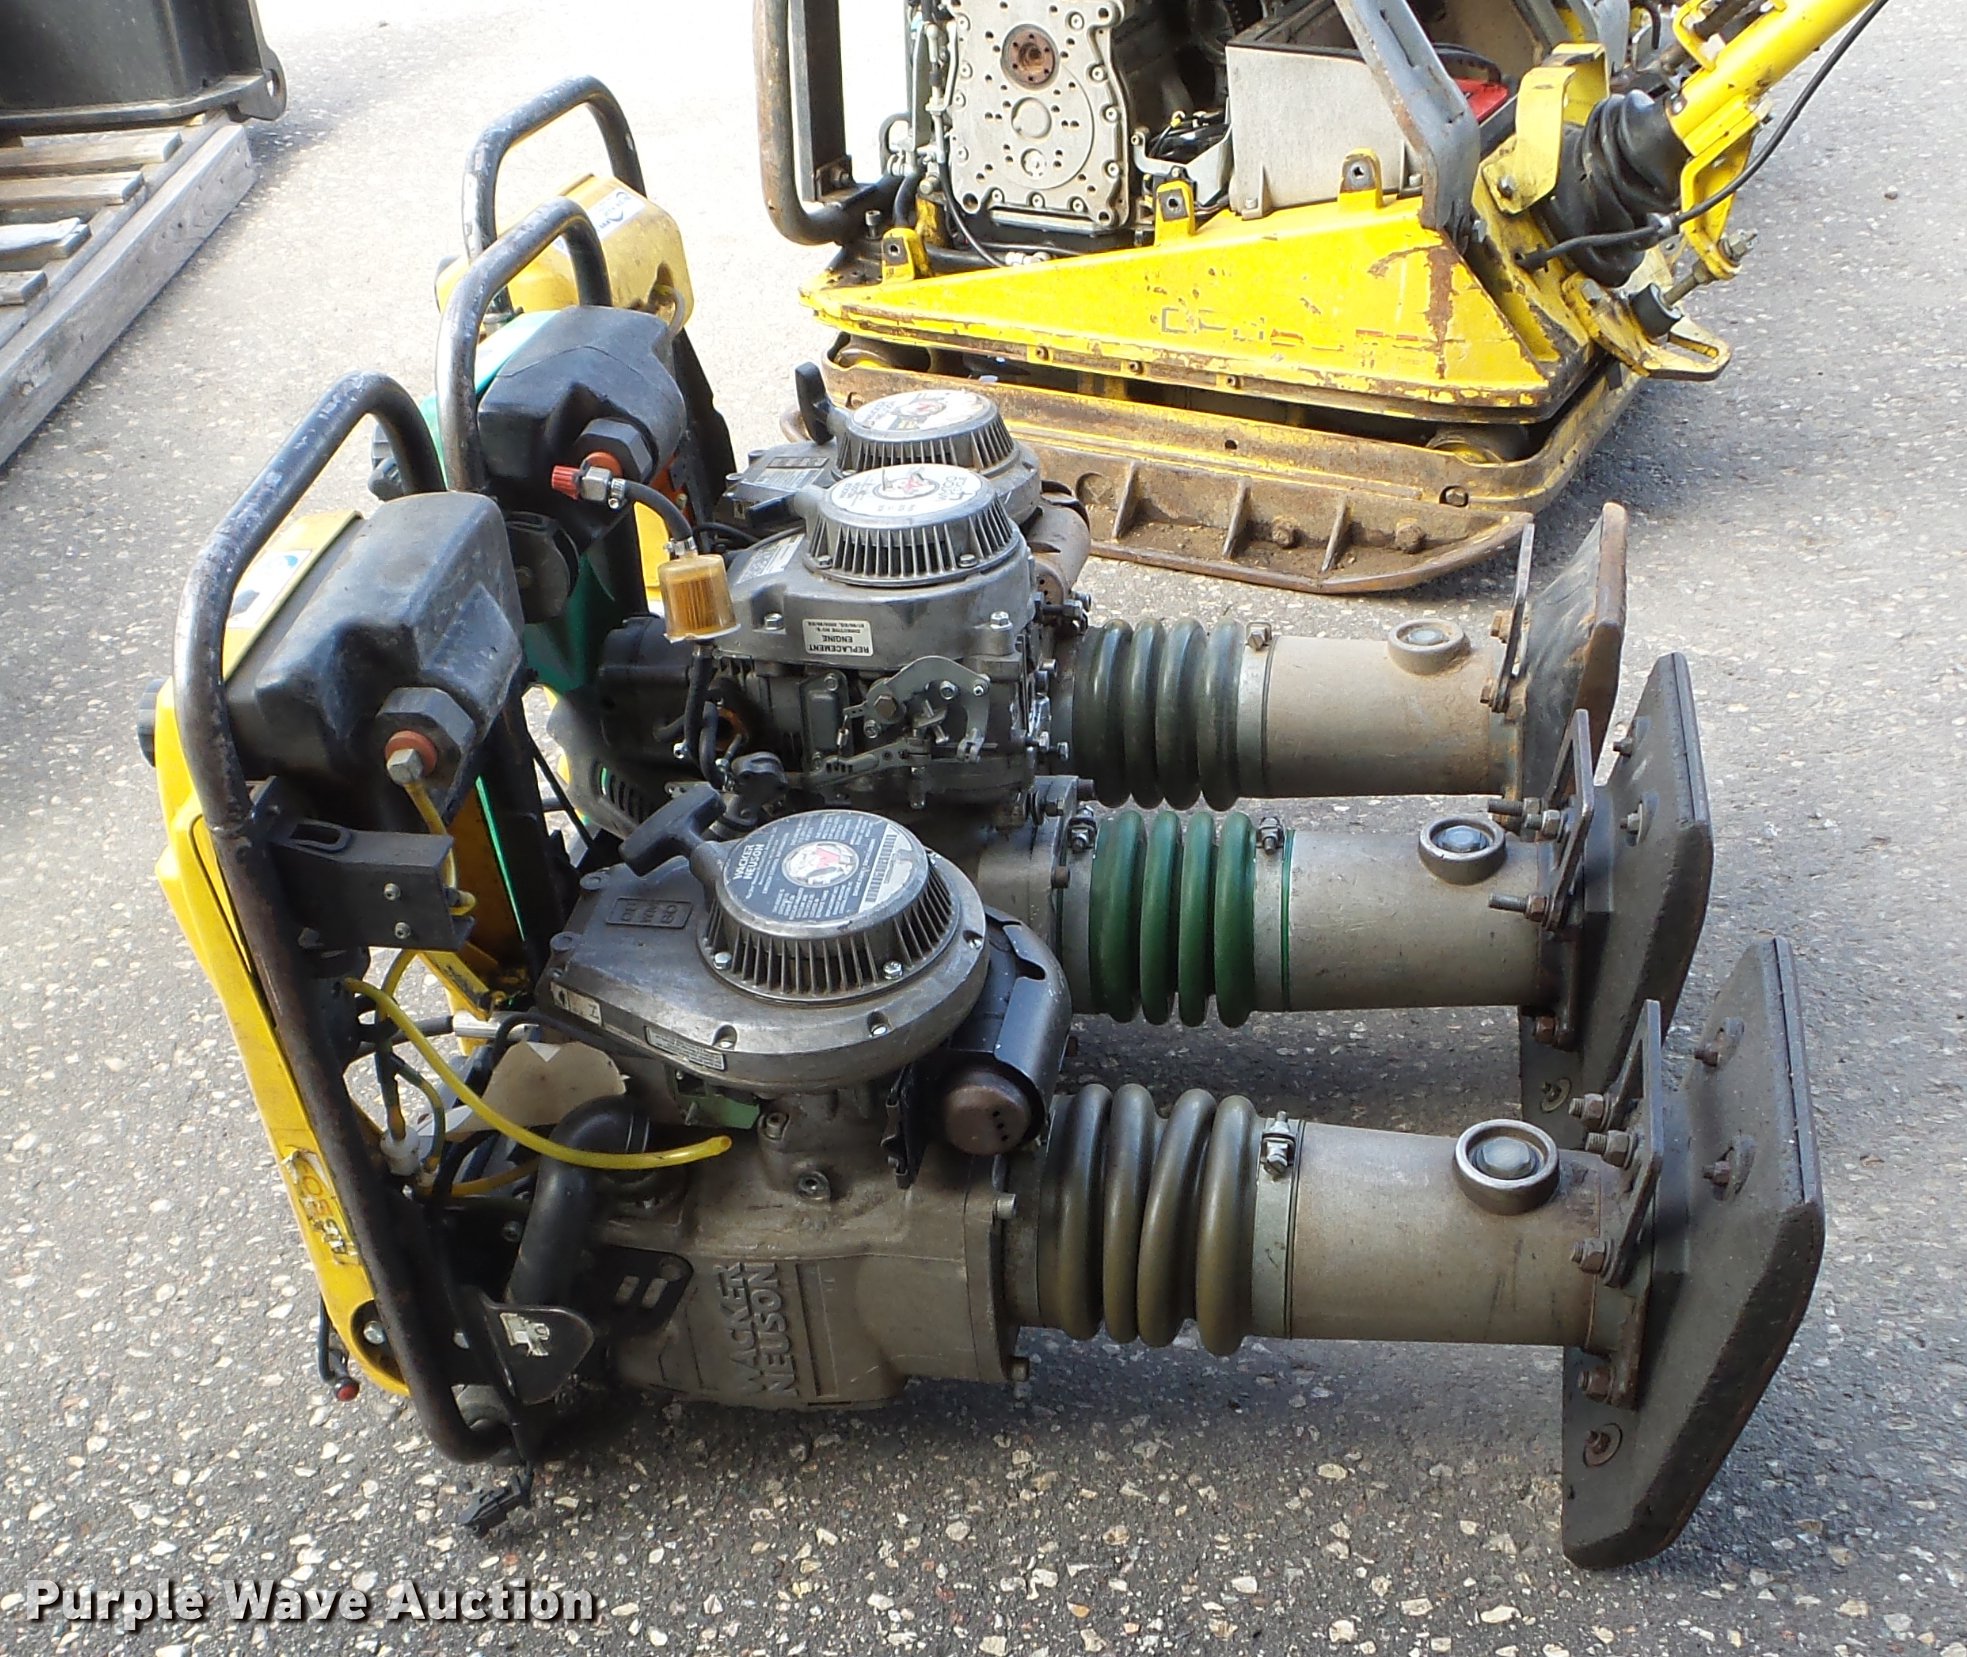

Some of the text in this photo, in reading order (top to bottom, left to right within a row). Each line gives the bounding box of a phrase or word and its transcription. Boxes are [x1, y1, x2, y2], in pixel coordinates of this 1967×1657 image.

[809, 644, 869, 653] REPLACEMENT
[822, 635, 853, 643] ENGINE
[732, 844, 755, 880] WACKER
[743, 843, 765, 880] NEUSON
[713, 1262, 768, 1395] WACKER
[744, 1262, 799, 1397] NEUSON
